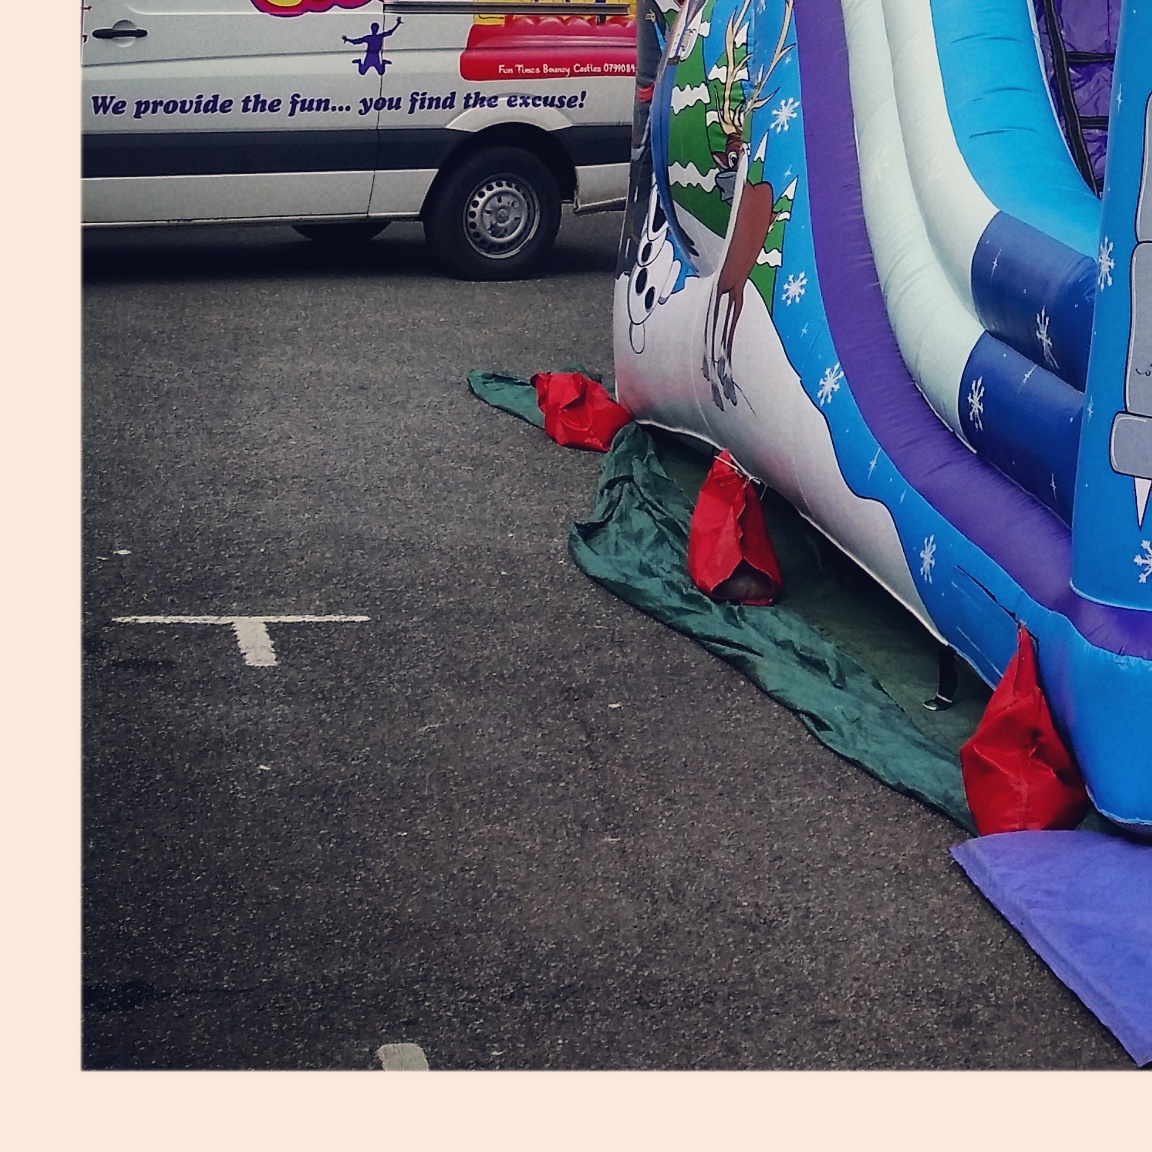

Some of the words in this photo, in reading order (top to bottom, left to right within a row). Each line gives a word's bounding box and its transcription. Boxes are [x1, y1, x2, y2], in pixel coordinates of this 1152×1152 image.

[498, 64, 514, 74] Fun
[542, 63, 571, 77] Bouncy
[91, 95, 127, 115] We
[133, 94, 234, 118] provide
[241, 93, 282, 113] the
[288, 93, 351, 117] fun...
[358, 96, 402, 115] you
[408, 91, 457, 114] find
[463, 91, 499, 108] the
[506, 90, 587, 109] excuse!
